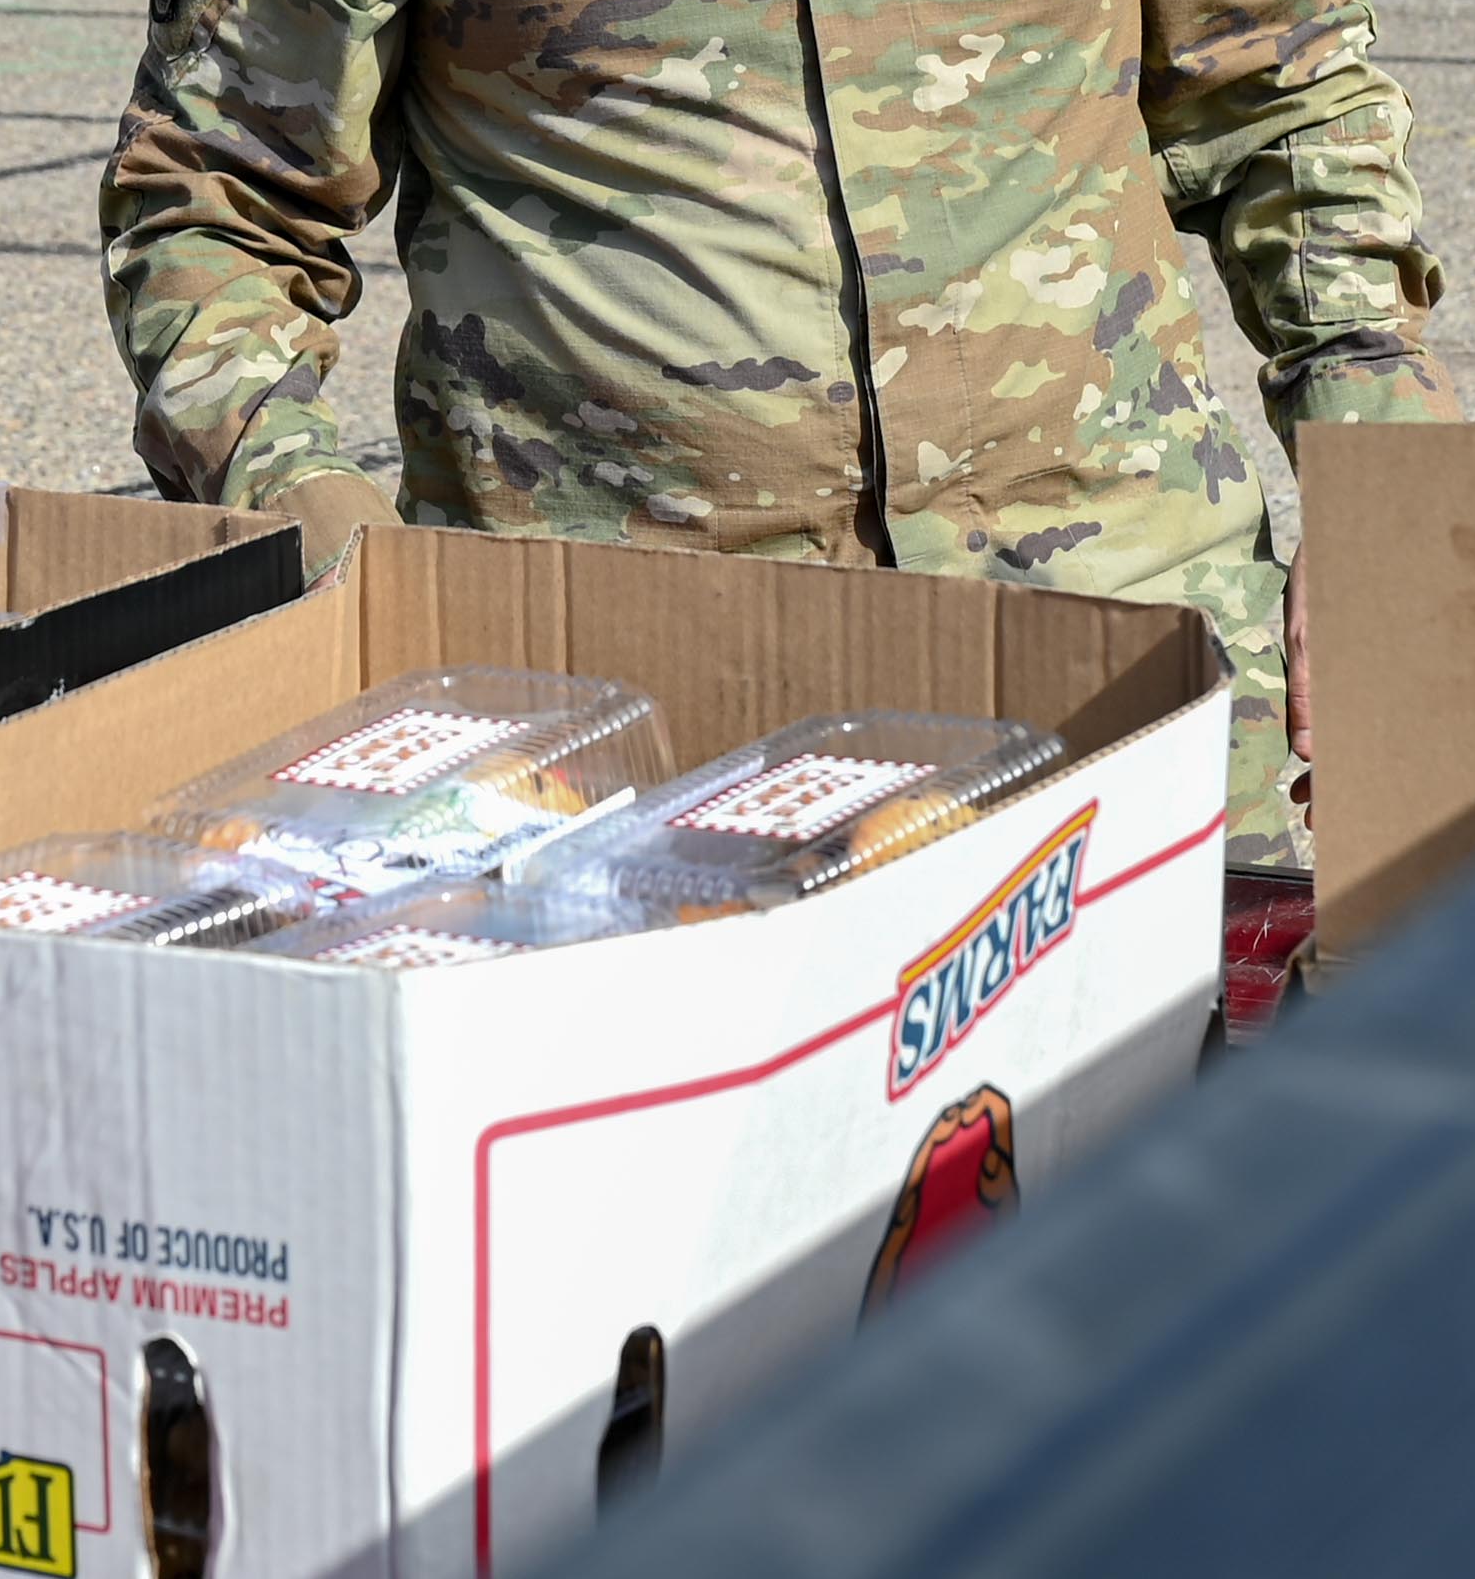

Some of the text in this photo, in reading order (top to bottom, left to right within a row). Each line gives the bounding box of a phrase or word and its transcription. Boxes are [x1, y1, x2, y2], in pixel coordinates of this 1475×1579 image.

[895, 835, 1083, 1082] FARMS
[28, 1205, 108, 1257] U.S.A.
[116, 1219, 149, 1262] OF
[158, 1226, 290, 1283] PRODUCE
[0, 1252, 290, 1328] PREMIUM APPLES
